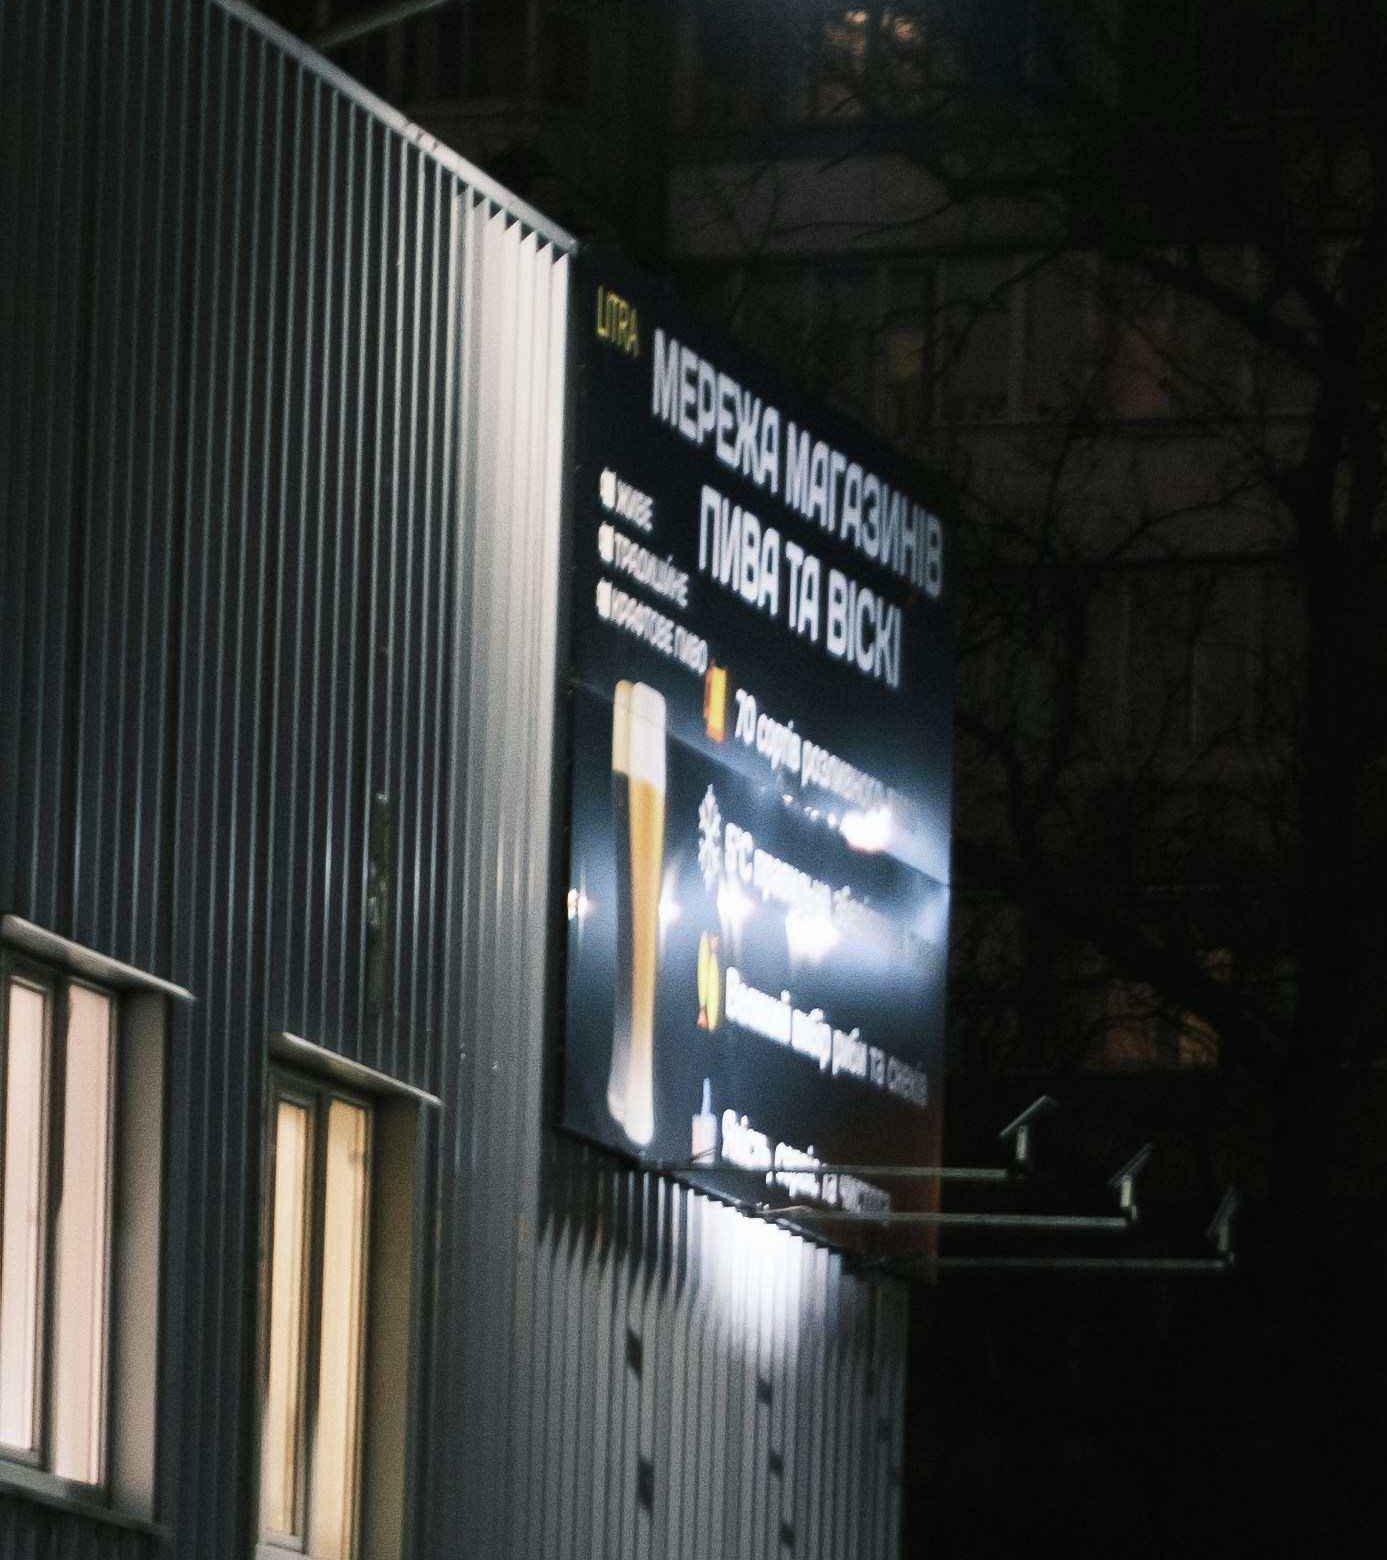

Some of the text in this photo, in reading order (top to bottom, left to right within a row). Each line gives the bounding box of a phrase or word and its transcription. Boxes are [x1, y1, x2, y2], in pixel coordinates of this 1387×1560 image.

[652, 326, 944, 599] МЕРЕЖА МАГАЗИНІВ
[698, 484, 902, 690] ПИВА ТА ВІСКІ
[734, 688, 757, 745] 70
